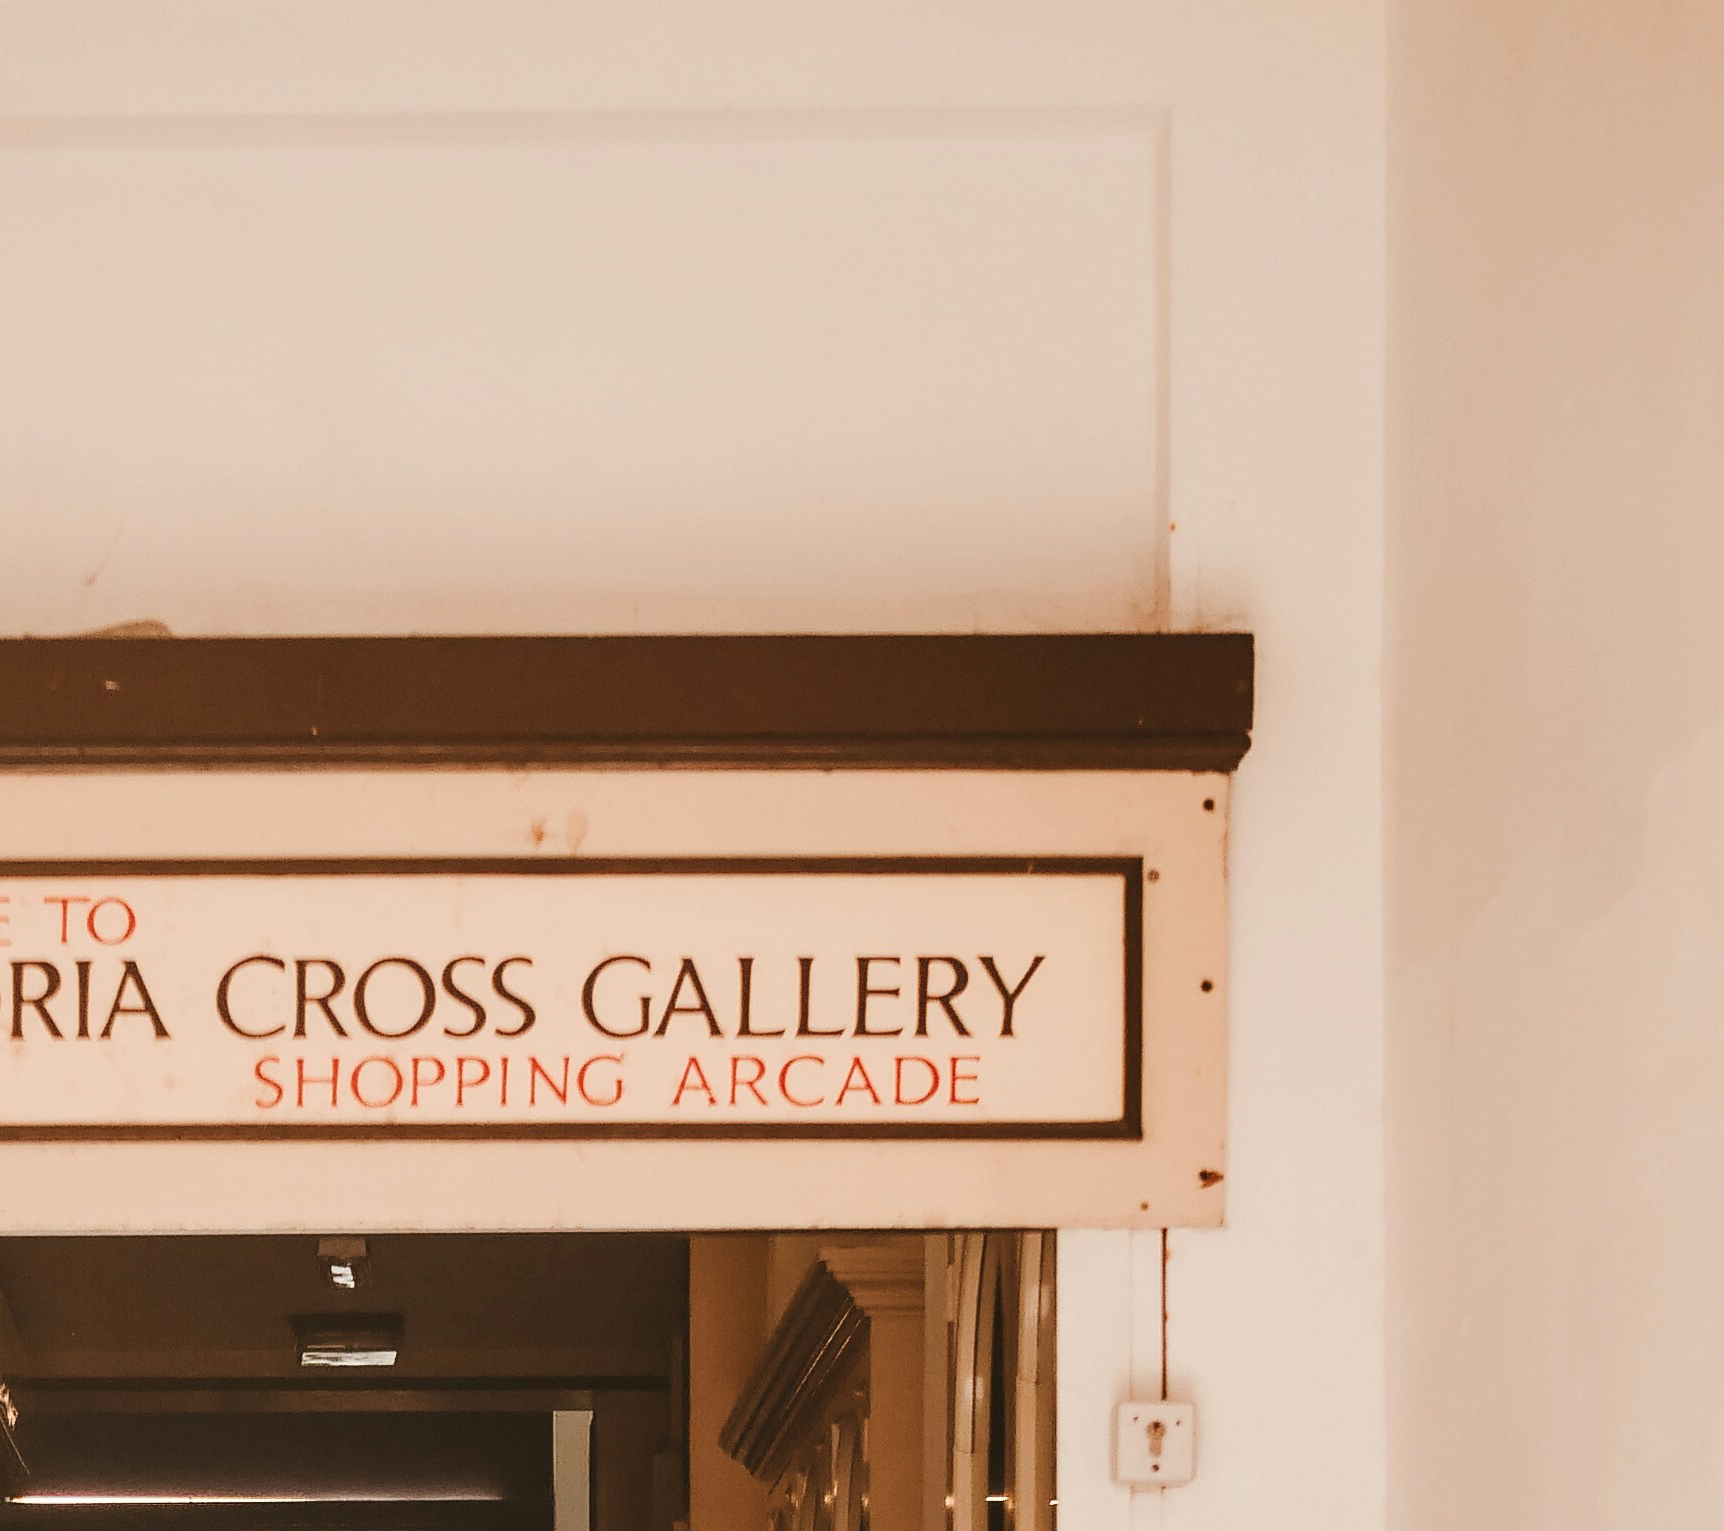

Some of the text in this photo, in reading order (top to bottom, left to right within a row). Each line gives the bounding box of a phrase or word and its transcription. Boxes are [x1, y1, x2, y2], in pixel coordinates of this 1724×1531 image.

[44, 897, 137, 945] TO
[215, 953, 538, 1042] CROSS
[580, 953, 1046, 1041] GALLERY
[253, 1055, 981, 1109] SHOPPING ARCADE
